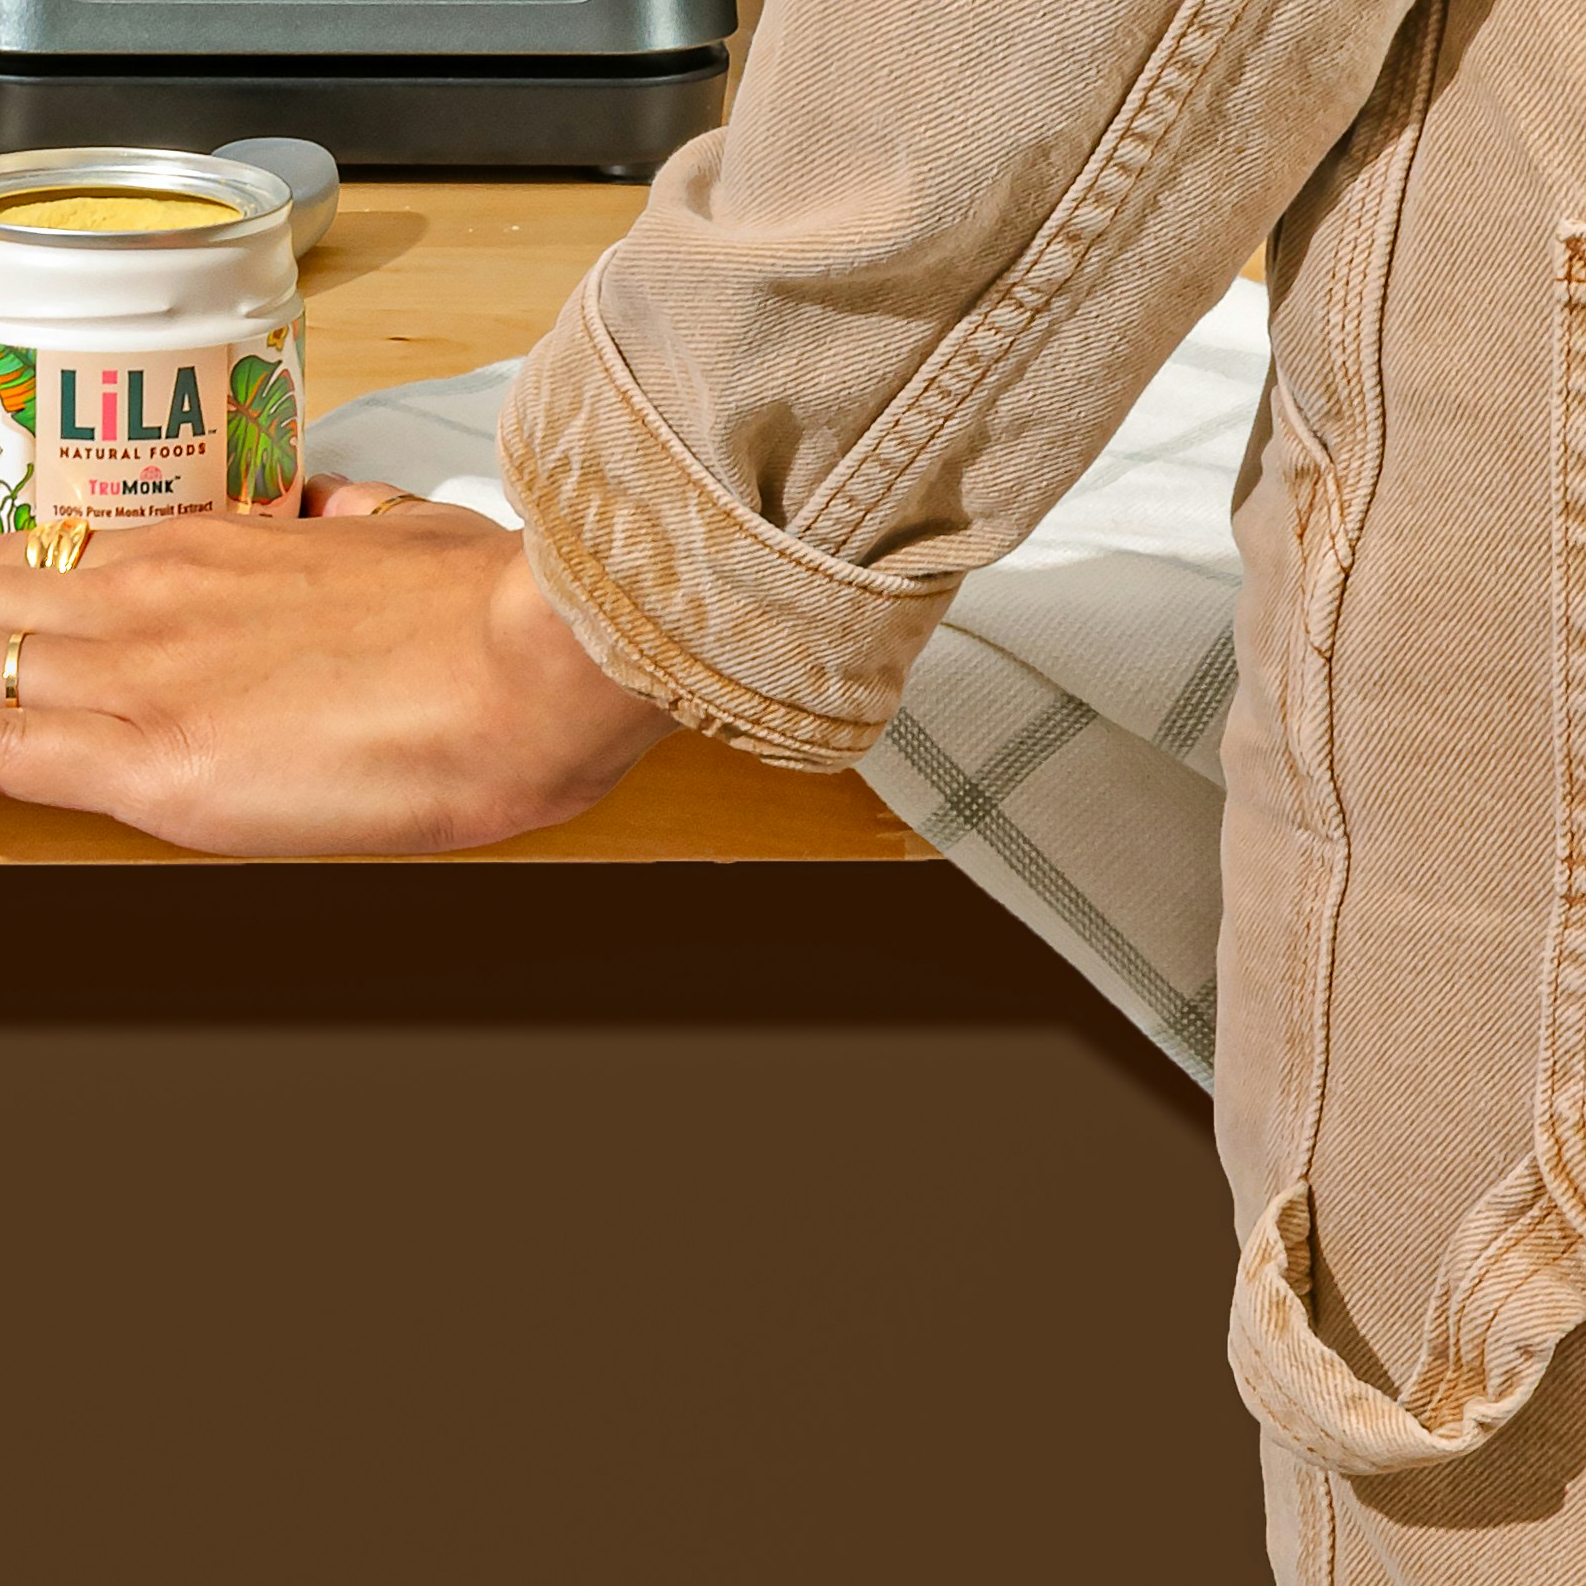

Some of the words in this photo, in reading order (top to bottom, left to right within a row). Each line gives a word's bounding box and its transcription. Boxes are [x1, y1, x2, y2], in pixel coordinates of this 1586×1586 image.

[60, 447, 141, 459] NATURAL
[150, 443, 206, 459] FOODS
[53, 505, 83, 517] 100%
[86, 505, 111, 517] Pure
[115, 505, 145, 517] Monk
[148, 504, 174, 516] Fruit
[178, 501, 213, 515] Extract
